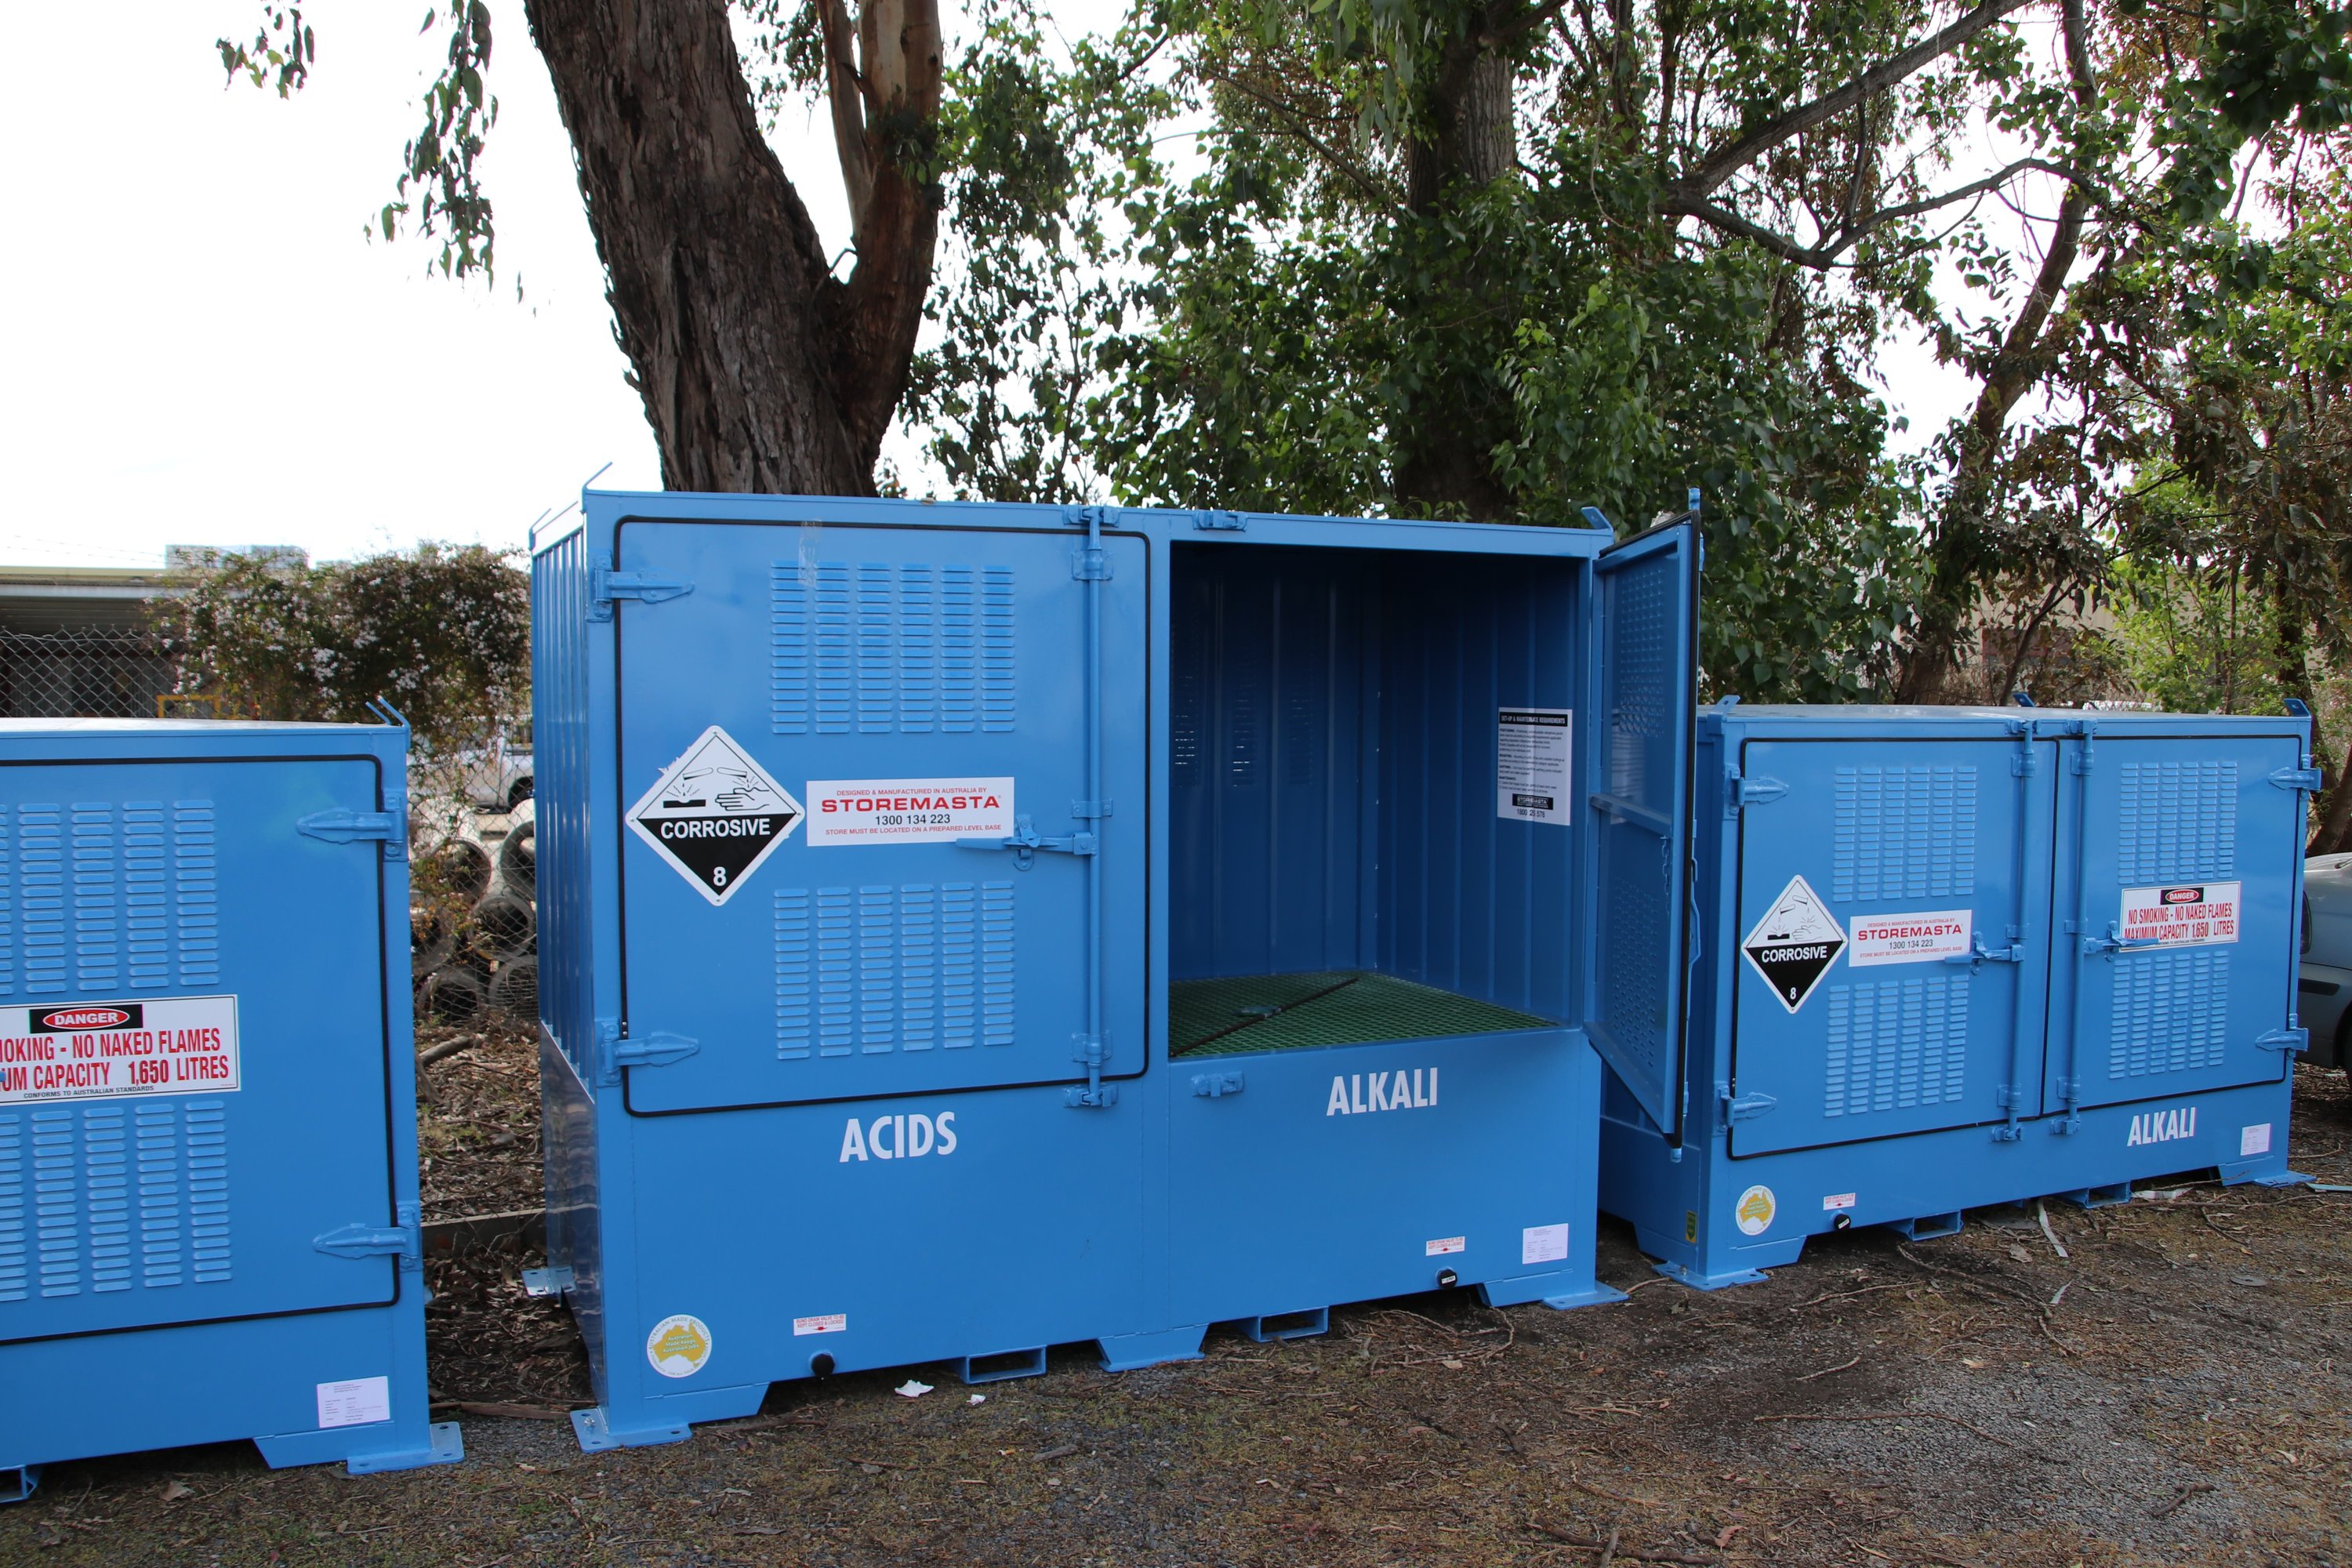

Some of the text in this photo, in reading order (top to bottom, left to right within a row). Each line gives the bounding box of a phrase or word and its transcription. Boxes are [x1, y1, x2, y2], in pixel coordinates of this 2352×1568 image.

[821, 795, 1000, 813] STOREMASTA
[660, 818, 771, 840] CORROSIVE
[875, 813, 950, 826] 1300 134 223
[713, 866, 728, 887] 8
[2169, 891, 2195, 901] DANGER
[2128, 909, 2138, 924] NO
[2139, 907, 2169, 924] SMOKING
[2175, 906, 2184, 921] NO
[2185, 904, 2206, 920] NAKED
[2208, 902, 2232, 919] FLAMES
[1857, 924, 1962, 941] STOREMASTA
[2124, 925, 2158, 940] MAXIMUM
[2159, 923, 2189, 941] CAPACITY
[2213, 920, 2234, 936] LITRES
[1889, 938, 1933, 949] 1300 134 223
[1761, 946, 1828, 963] CORROSIVE
[1790, 987, 1797, 1000] 8
[54, 1011, 118, 1026] DANGER
[0, 1036, 55, 1063] OKING
[72, 1034, 94, 1058] NO
[100, 1031, 153, 1057] NAKED
[158, 1027, 221, 1054] FLAMES
[0, 1054, 229, 1092] UM CAPACITY 1,650 LITRES
[1327, 1067, 1438, 1116] ALKALI
[839, 1111, 957, 1163] ACIDS
[2127, 1106, 2196, 1147] ALKALI
[649, 1320, 670, 1349] AUSTRALIAN
[690, 1318, 710, 1342] PRODUCTS
